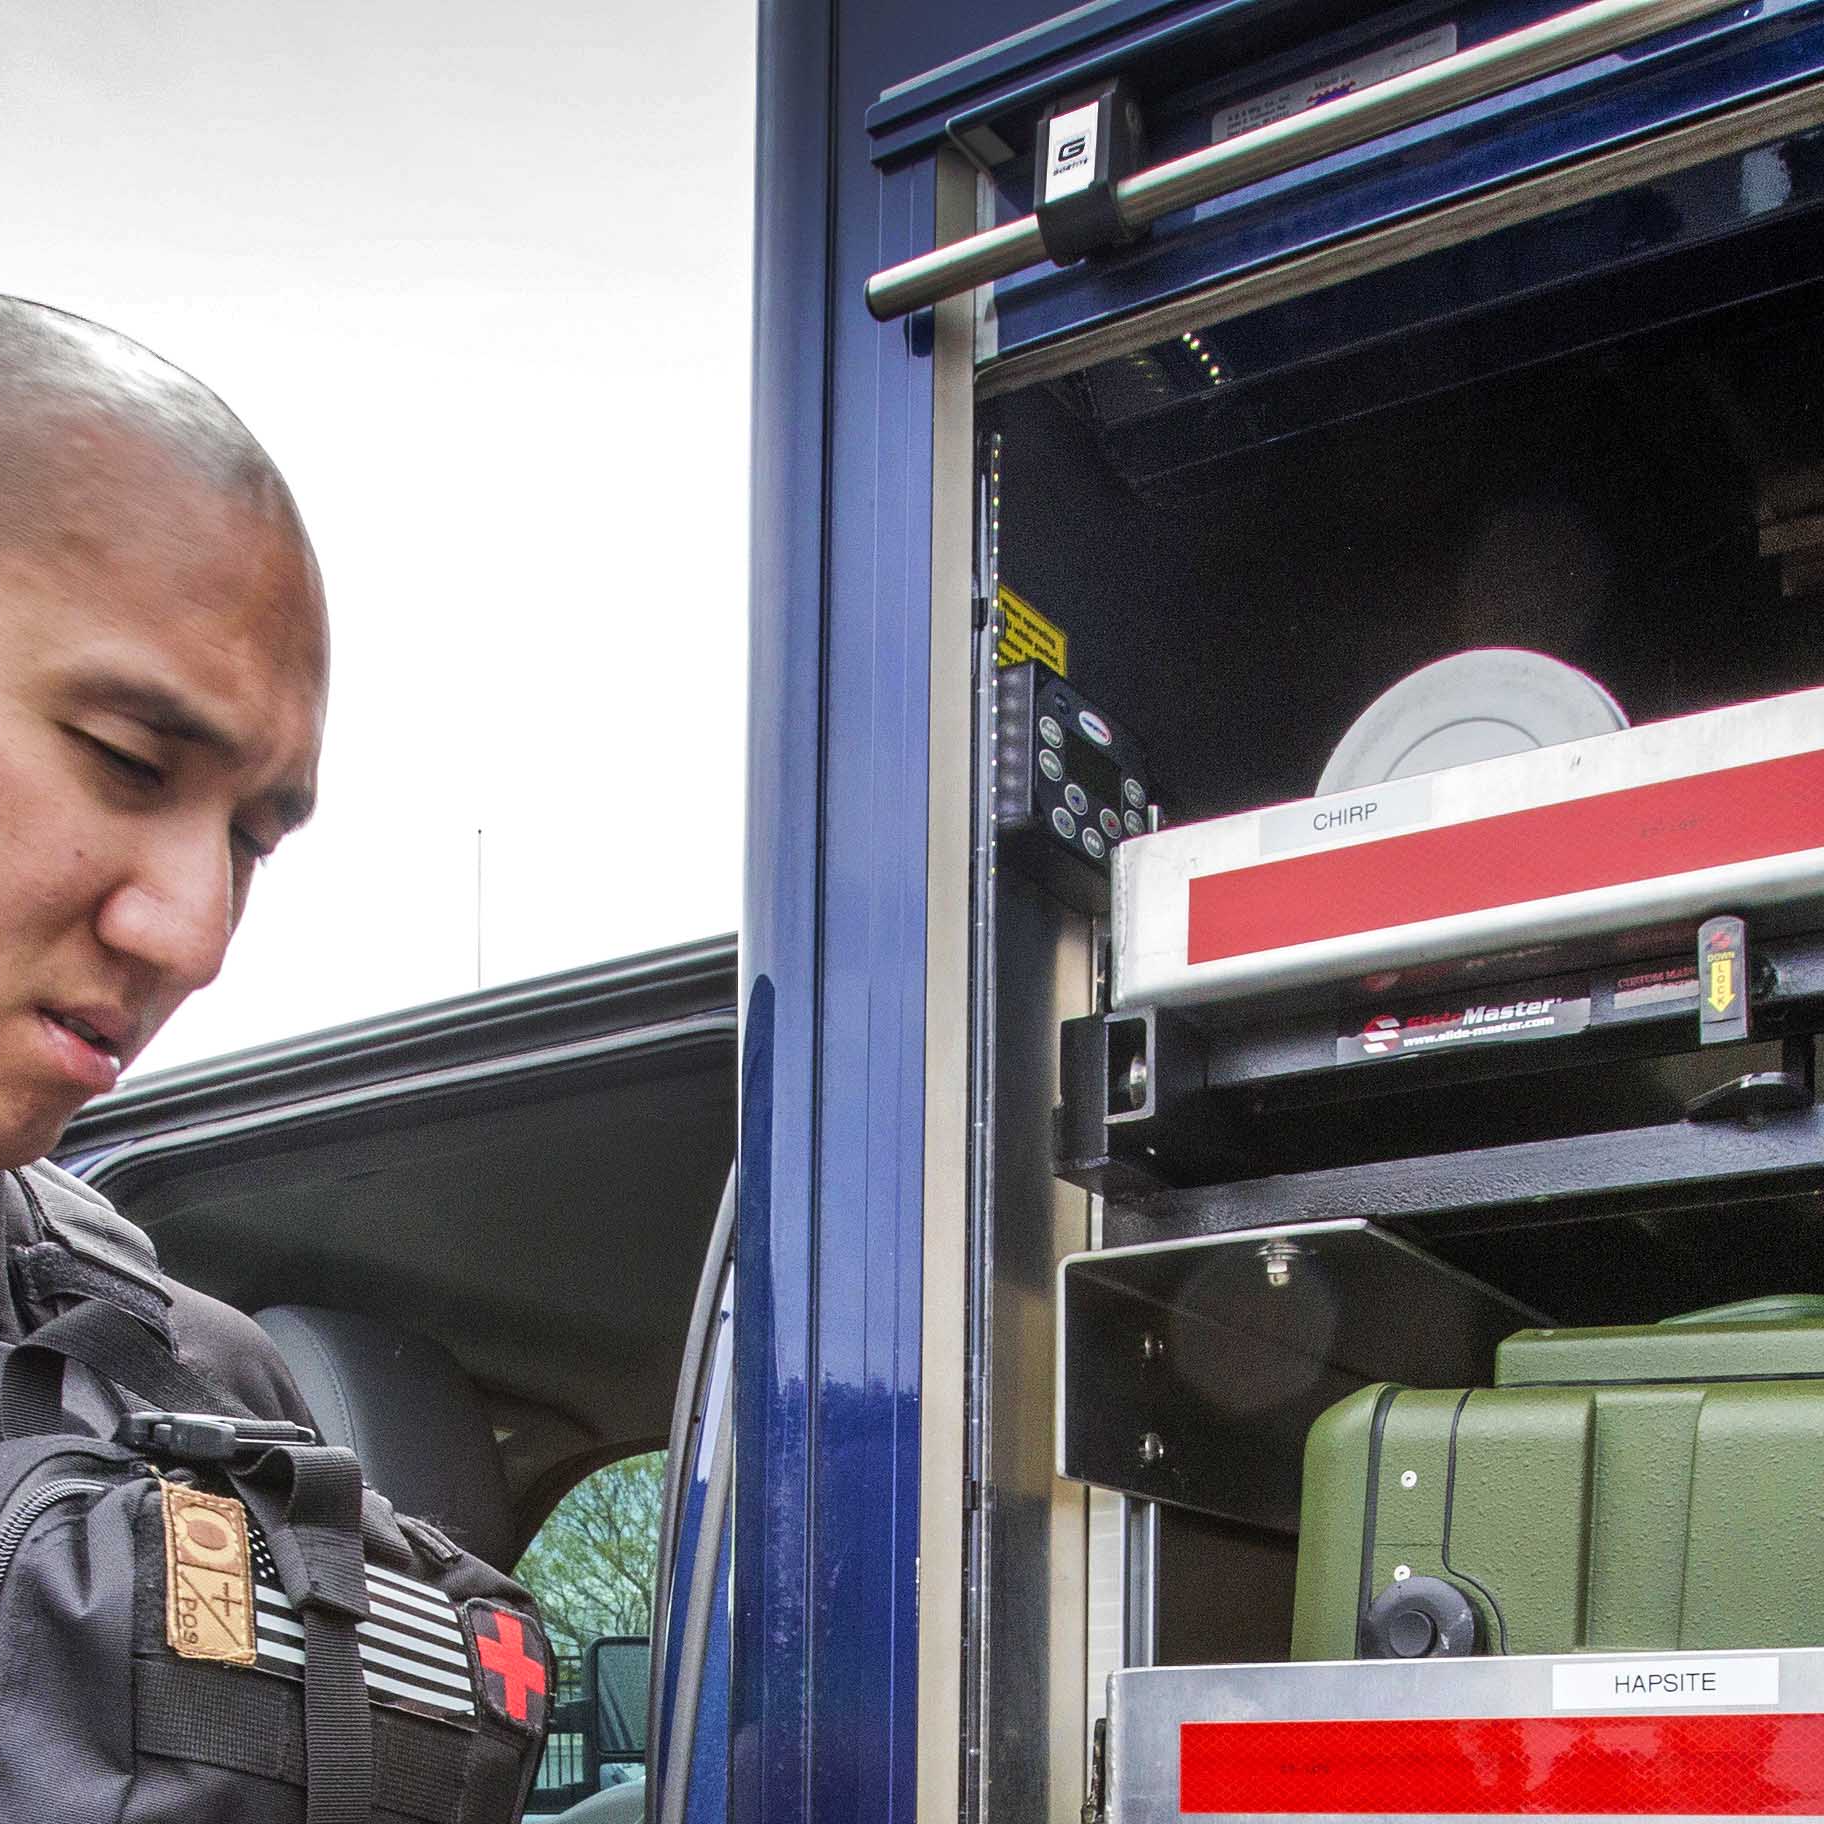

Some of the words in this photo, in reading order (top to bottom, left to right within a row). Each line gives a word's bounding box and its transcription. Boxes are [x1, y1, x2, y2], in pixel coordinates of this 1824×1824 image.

[1313, 802, 1378, 831] CHIRP
[1707, 951, 1736, 962] DOWN
[1717, 963, 1726, 1007] LOCK
[1403, 1015, 1556, 1048] www.slide-master.com
[1615, 1672, 1717, 1694] HAPSITE
